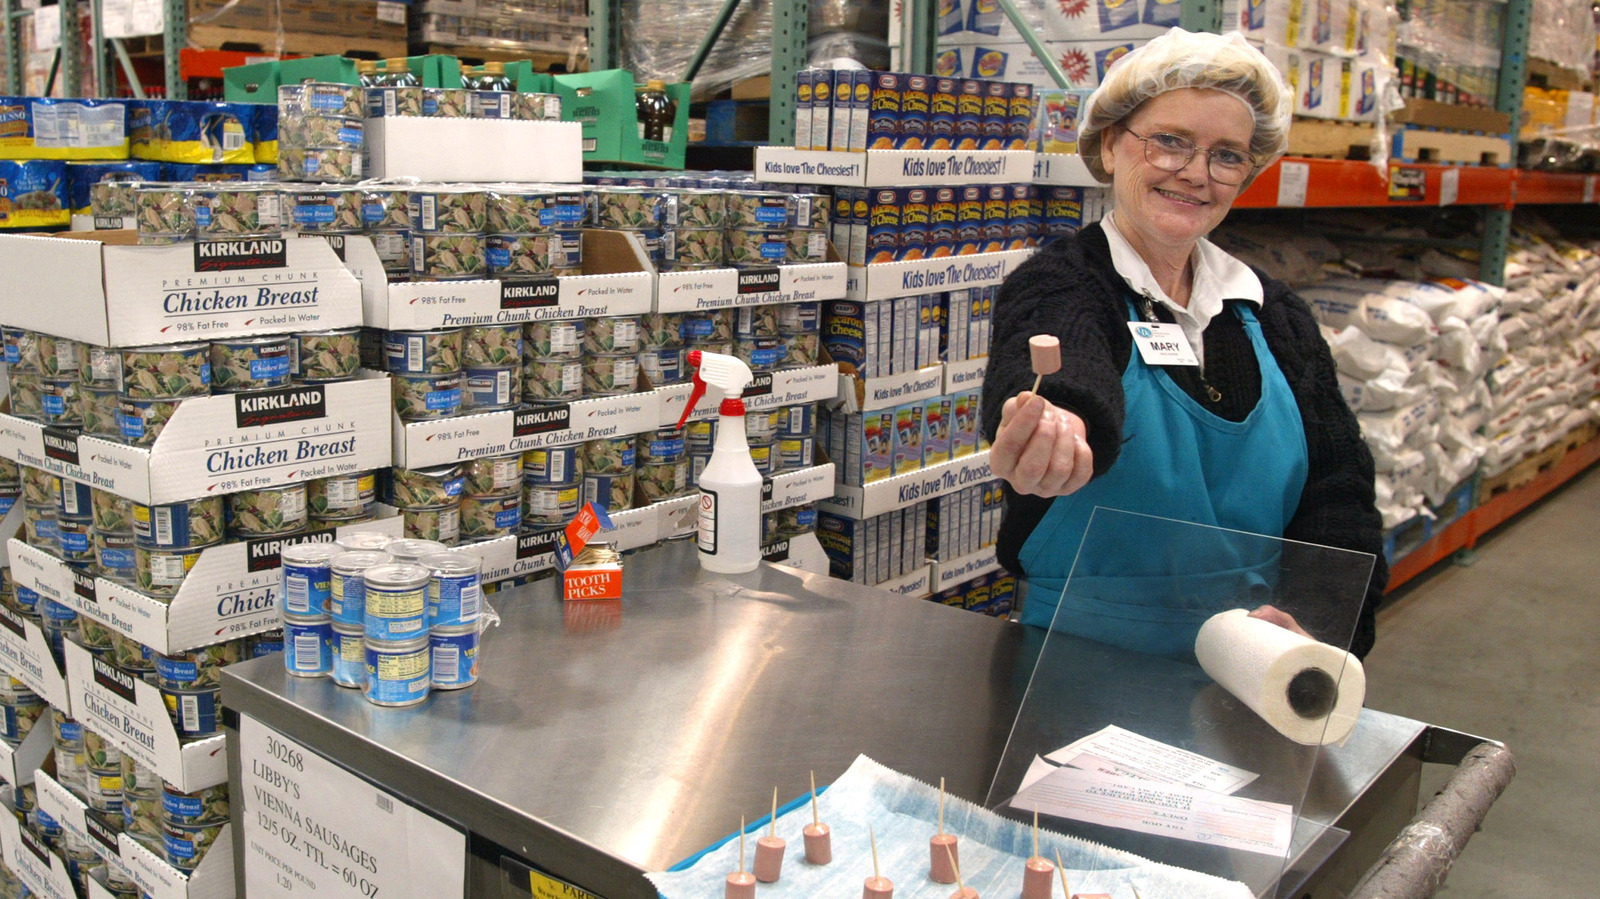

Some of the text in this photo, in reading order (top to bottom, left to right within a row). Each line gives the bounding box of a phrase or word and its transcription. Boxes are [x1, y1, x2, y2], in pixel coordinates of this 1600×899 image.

[878, 100, 899, 112] Cheese
[765, 161, 782, 173] Kids
[783, 161, 800, 174] love
[801, 161, 814, 174] The
[903, 158, 924, 177] Kids
[925, 157, 946, 176] love
[947, 156, 964, 176] The
[96, 217, 122, 228] KIRKLAND
[877, 213, 898, 226] Cheese
[199, 240, 283, 257] KIRKLAND
[162, 272, 318, 287] PREMIUM CHUNK
[740, 274, 779, 285] KIRKLAND
[902, 270, 923, 290] Kids
[925, 268, 945, 286] love
[946, 264, 962, 283] The
[163, 286, 318, 313] Chicken Breast
[421, 297, 437, 305] 98%
[438, 296, 450, 304] Fat
[504, 285, 557, 298] KIRKLAND
[588, 288, 608, 296] Packed
[617, 286, 634, 294] Water
[697, 290, 815, 308] Premium Chunk Chicken Breast
[442, 304, 608, 326] Premium Chunk Chicken Breast
[834, 304, 858, 313] KRAFT
[176, 322, 194, 331] 98%
[197, 321, 210, 330] Fat
[212, 320, 229, 329] Free
[260, 316, 286, 325] Packed
[297, 313, 320, 322] Water
[831, 324, 863, 339] Cheese
[1149, 341, 1180, 352] MARY
[952, 370, 976, 384] Kids love
[754, 394, 784, 407] Chicken
[785, 390, 808, 402] Breast
[873, 389, 889, 400] Kids
[890, 386, 902, 397] love
[903, 382, 912, 394] The
[240, 391, 322, 412] KIRKLAND
[437, 433, 452, 441] 98%
[453, 431, 465, 439] Fat
[466, 429, 480, 437] Free
[516, 410, 568, 426] KIRKLAND
[597, 409, 617, 417] Packed
[625, 405, 642, 413] Water
[44, 434, 77, 453] KIRKLAND
[205, 421, 356, 447] PREMIUM CHUNK
[457, 425, 617, 459] Premium Chunk Chicken Breast
[206, 435, 356, 473] Chicken Breast
[17, 448, 115, 489] Premium Chunk Chicken Breast
[220, 462, 358, 490] 98% Fat Free Packed In Water
[898, 462, 993, 503] Kids love The Cheesies
[785, 493, 807, 505] Breast
[513, 556, 546, 573] Chunk
[565, 573, 611, 588] TOOTH
[941, 570, 954, 581] Kids
[314, 581, 331, 590] VIEN
[568, 584, 606, 600] PICKS
[217, 586, 275, 617] Chick
[84, 600, 110, 621] Chicken
[111, 613, 133, 633] Breast
[230, 617, 279, 633] 98% Fat Free
[20, 651, 43, 680] Breast
[94, 658, 134, 690] KIRKLAND
[84, 692, 120, 729] Chicken
[123, 715, 155, 750] Breast
[266, 736, 304, 773] 30268
[252, 759, 301, 799] LIBBY'S
[253, 785, 378, 874] VIENNA SAUSAGES
[257, 811, 379, 899] 12/5 OZ. TTL = 60 OZ
[251, 841, 316, 890] UNIT PRICE PER POUND
[276, 873, 292, 891] 1.20
